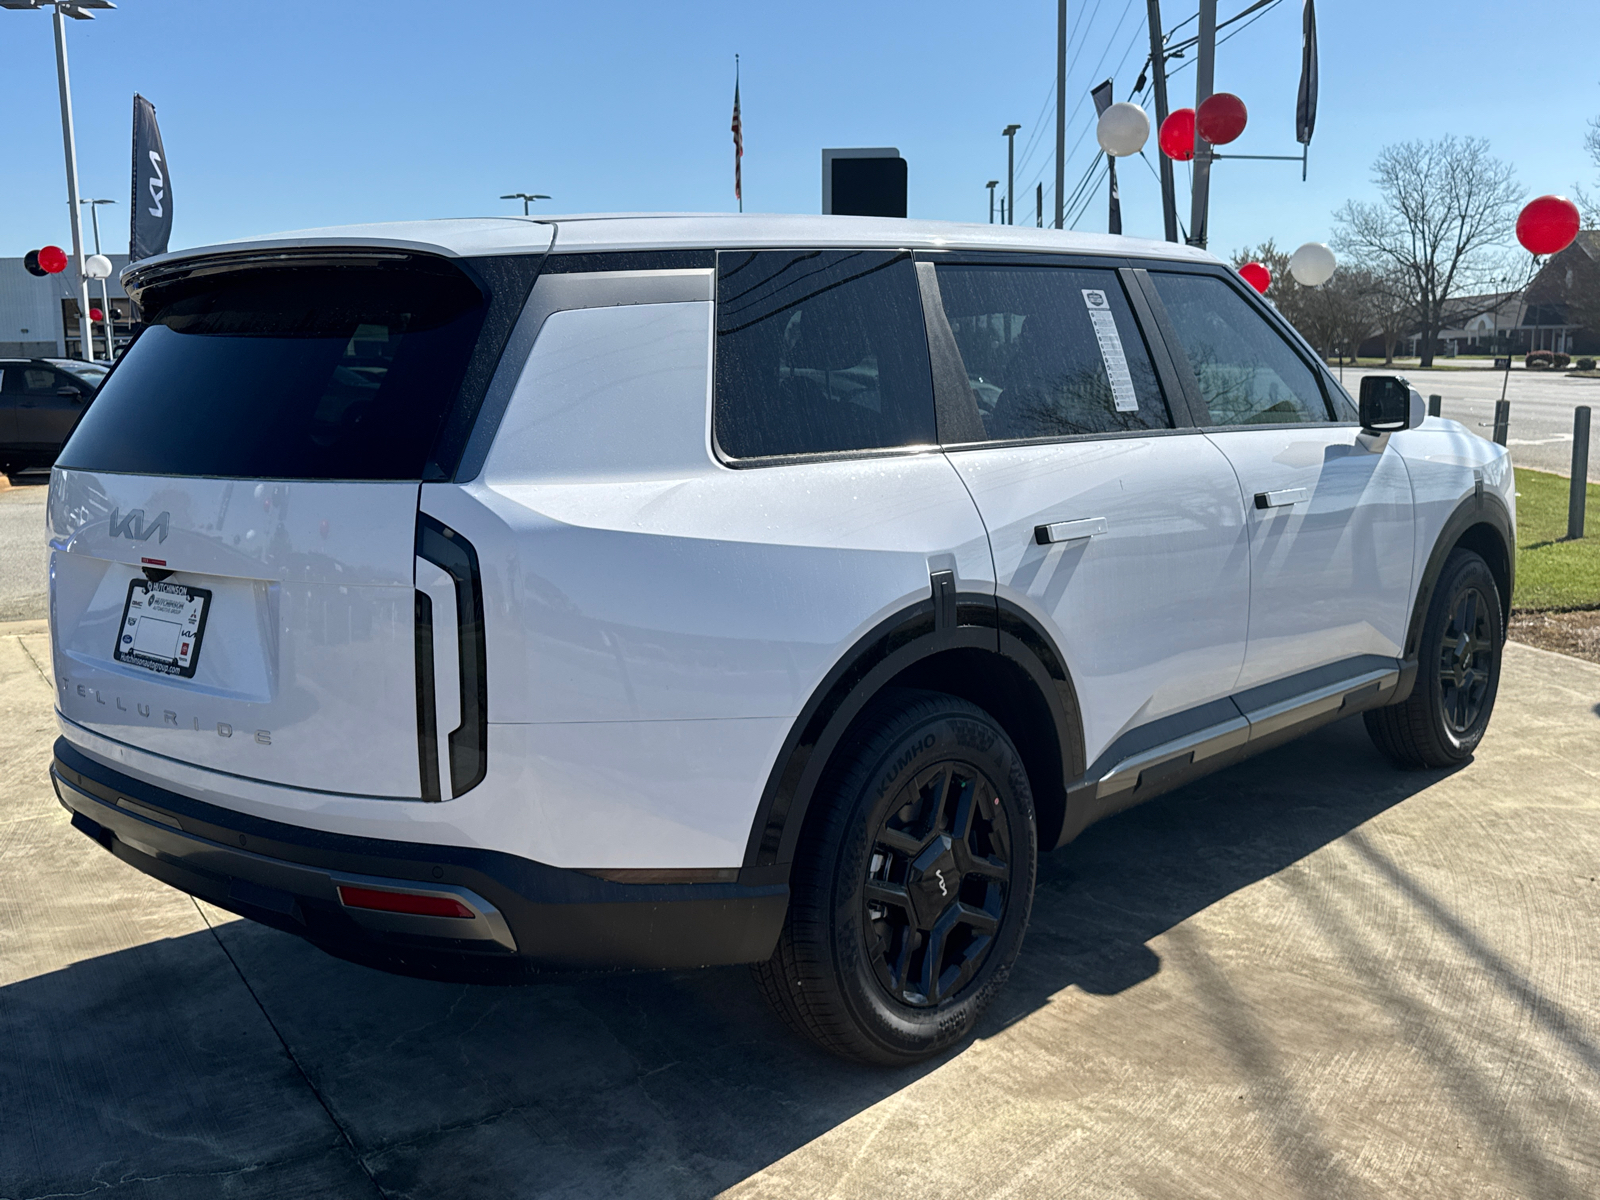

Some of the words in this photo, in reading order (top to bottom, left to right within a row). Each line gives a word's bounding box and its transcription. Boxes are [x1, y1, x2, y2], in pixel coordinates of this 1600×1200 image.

[148, 150, 163, 218] KIA
[109, 506, 170, 545] KIA
[153, 583, 187, 596] HUTCHINSON
[62, 677, 272, 745] TELLURIDE
[875, 733, 937, 799] KUMHO
